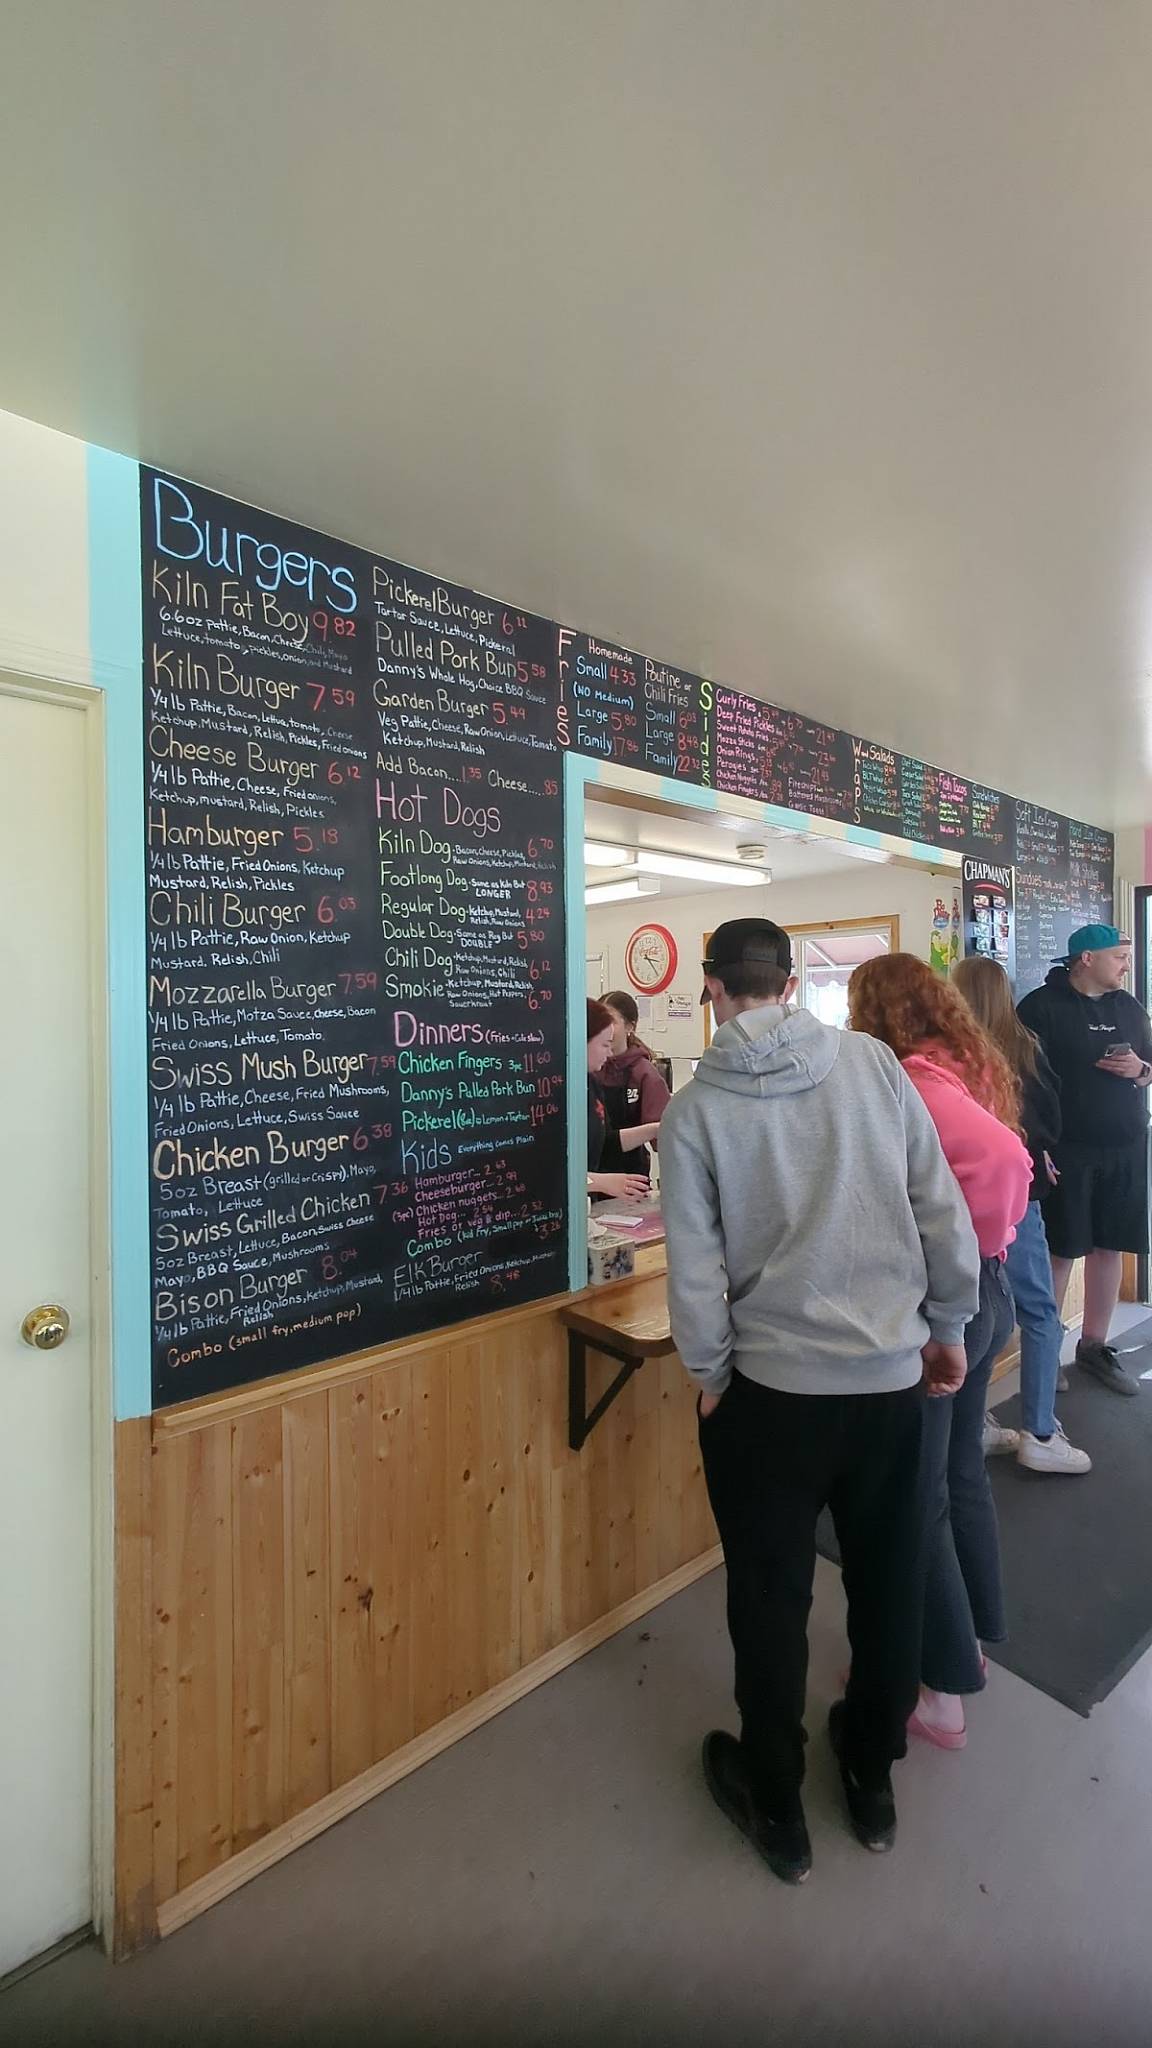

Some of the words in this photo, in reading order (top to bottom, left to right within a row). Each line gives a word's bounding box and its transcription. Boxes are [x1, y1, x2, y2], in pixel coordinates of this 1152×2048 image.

[154, 478, 358, 613] Burgers
[153, 560, 208, 609] Kiln
[221, 582, 254, 620] Fat
[262, 593, 308, 643] Boy
[373, 566, 435, 613] Pickerel
[437, 587, 495, 629] Burger
[376, 621, 432, 660] Pulled
[441, 640, 480, 672] Pork
[486, 651, 516, 678] Bun
[588, 638, 632, 664] Homemade
[154, 643, 210, 690] Kiln
[217, 654, 301, 709] Burger
[577, 656, 607, 680] Small
[645, 659, 681, 687] Poutine
[373, 679, 434, 711] Garden
[437, 688, 488, 718] Burger
[645, 683, 666, 702] Chili
[669, 689, 688, 707] Fries
[716, 689, 737, 708] Curly
[739, 695, 756, 712] Fries
[377, 711, 398, 732] Veg
[577, 701, 608, 723] Large
[646, 703, 675, 725] Small
[578, 725, 612, 756] Family
[646, 722, 674, 745] Large
[149, 725, 237, 767] Cheese
[248, 742, 319, 786] Burger
[376, 752, 402, 773] Add
[645, 743, 677, 775] Family
[869, 745, 894, 765] Salads
[287, 804, 325, 819] Pickles
[376, 778, 428, 823] Hot
[443, 787, 501, 837] Dogs
[148, 806, 284, 856] Hamburger
[378, 827, 414, 854] Kiln
[303, 861, 344, 880] Ketchup
[381, 861, 442, 893] Footlong
[964, 860, 1010, 889] CHAPMAN'S
[253, 876, 295, 892] Pickles
[476, 888, 511, 899] LONGER
[151, 891, 214, 926] Chili
[223, 893, 305, 930] Burger
[381, 893, 434, 918] Regular
[171, 934, 187, 950] lb
[241, 932, 267, 945] Raw
[309, 931, 350, 944] Ketchup
[382, 920, 426, 940] Double
[461, 938, 493, 949] DOUBLE
[253, 948, 281, 965] Chili
[385, 947, 418, 968] Chili
[149, 975, 266, 1007] Mozzarella
[271, 976, 337, 1005] Burger
[386, 974, 445, 999] Smokie
[394, 1011, 484, 1047] Dinners
[152, 1037, 185, 1051] Fried
[150, 1056, 232, 1090] Swiss
[241, 1052, 296, 1081] Mush
[303, 1049, 369, 1084] Burger
[398, 1051, 453, 1074] Chicken
[459, 1051, 502, 1076] Fingers
[296, 1087, 325, 1100] Fried
[492, 1081, 513, 1096] Pork
[516, 1080, 535, 1094] Bun
[289, 1110, 324, 1124] Swiss
[326, 1106, 360, 1119] Sauce
[153, 1137, 259, 1181] Chicken
[267, 1130, 349, 1165] Burger
[402, 1137, 452, 1174] Kids
[203, 1175, 262, 1195] Breast
[219, 1196, 264, 1214] Lettuce
[416, 1200, 456, 1217] Chicken
[156, 1223, 232, 1252] Swiss
[236, 1205, 296, 1234] Grilled
[301, 1190, 371, 1222] Chicken
[418, 1215, 437, 1227] Hot
[418, 1225, 450, 1239] Fries
[452, 1223, 462, 1231] or
[407, 1236, 452, 1257] Combo
[197, 1262, 228, 1280] BBQ
[427, 1252, 483, 1277] Burger
[155, 1287, 233, 1321] Bison
[240, 1268, 308, 1301] Burger
[243, 1311, 274, 1327] Relish
[167, 1342, 222, 1368] Combo
[294, 1313, 332, 1331] medium
[336, 1302, 361, 1326] pop)
